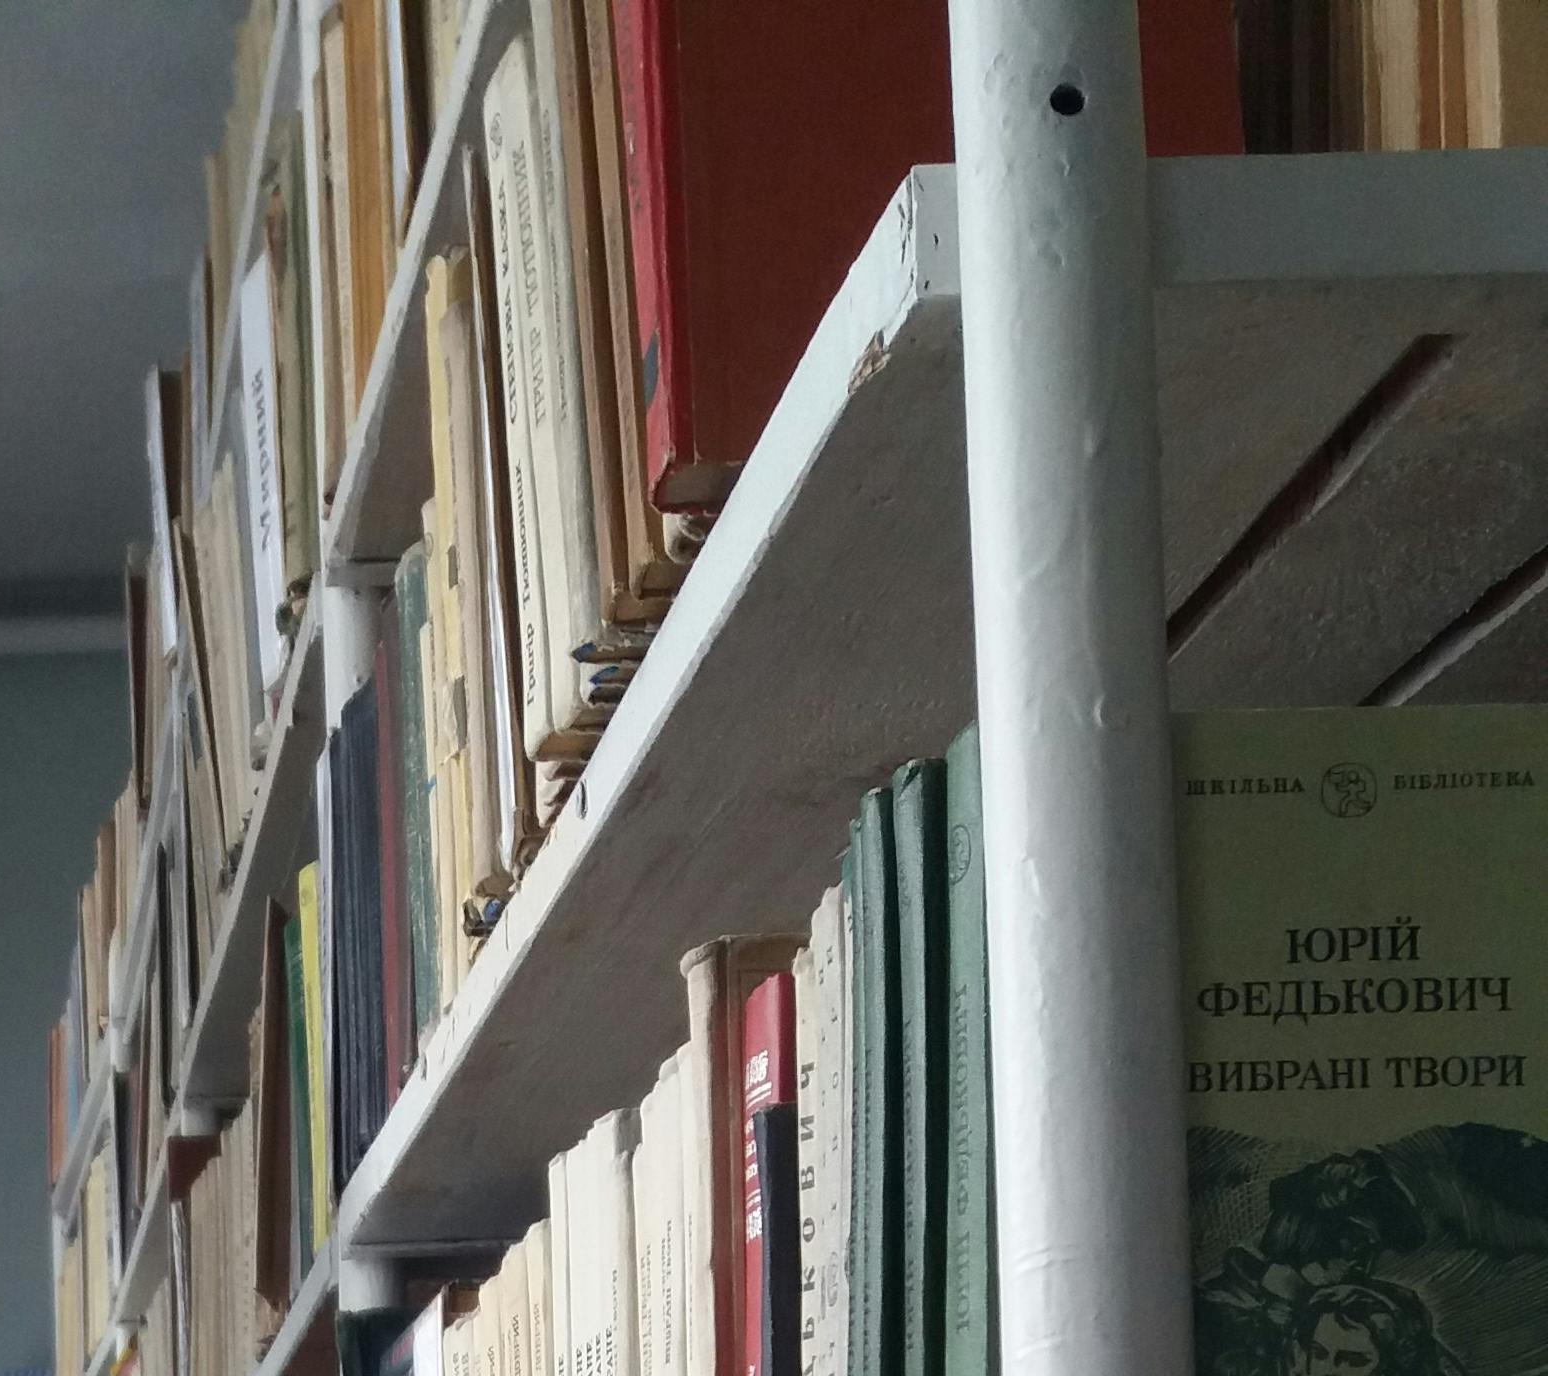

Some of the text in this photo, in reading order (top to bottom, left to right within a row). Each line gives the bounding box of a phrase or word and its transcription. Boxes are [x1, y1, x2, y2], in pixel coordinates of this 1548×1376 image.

[513, 140, 546, 428] ГРИГІР ТЮТЮННИК
[251, 368, 270, 553] Мирний
[499, 178, 535, 706] Григір Тютюнник СТЕПОВА КАЗКА
[1185, 769, 1535, 797] ШКІЛЬНА БІБЛІОТЕКА
[1286, 916, 1422, 964] ЮРІЙ
[1196, 976, 1512, 1026] ФЕДЬКОВИЧ
[1187, 1054, 1528, 1094] ВИБРАНІ ТВОРИ
[953, 983, 972, 1333] ЮРІЙ ФЕДЬКОВИЧ
